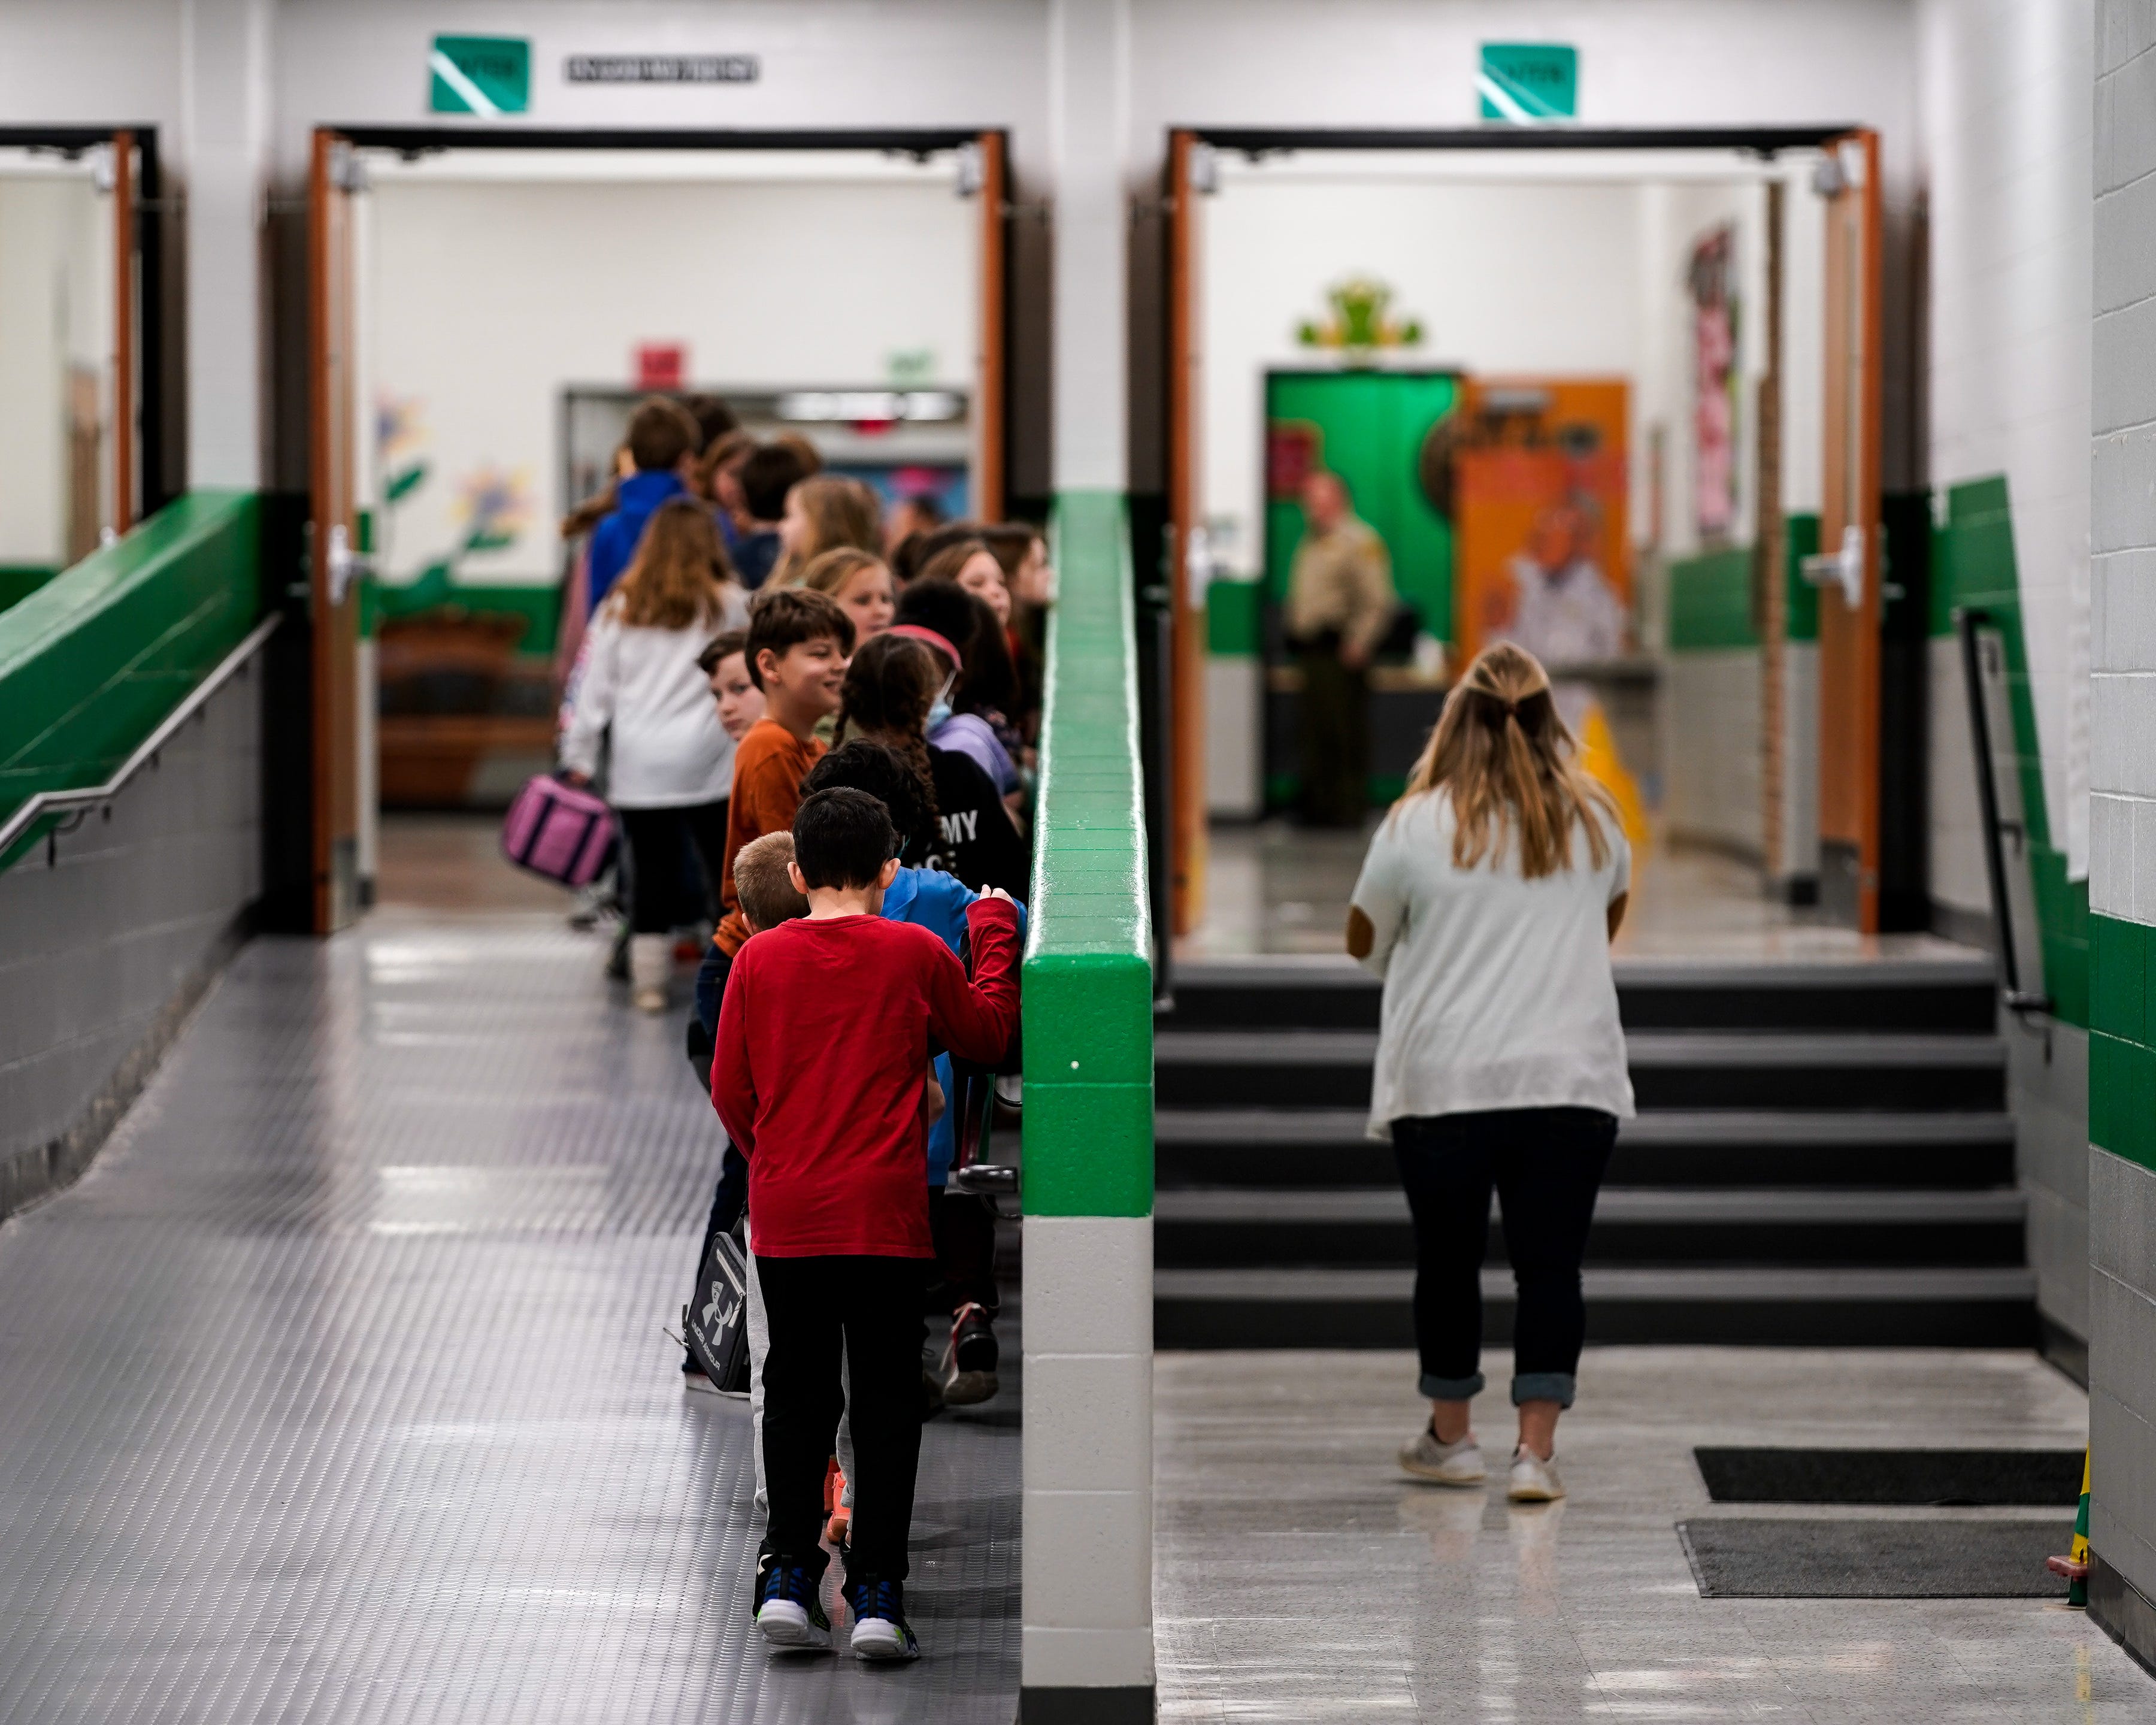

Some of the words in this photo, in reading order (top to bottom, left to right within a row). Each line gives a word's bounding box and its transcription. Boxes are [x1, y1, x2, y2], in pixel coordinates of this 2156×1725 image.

[926, 810, 978, 851] MY
[692, 1319, 705, 1345] UNDER
[702, 1342, 720, 1370] ARMOUR
